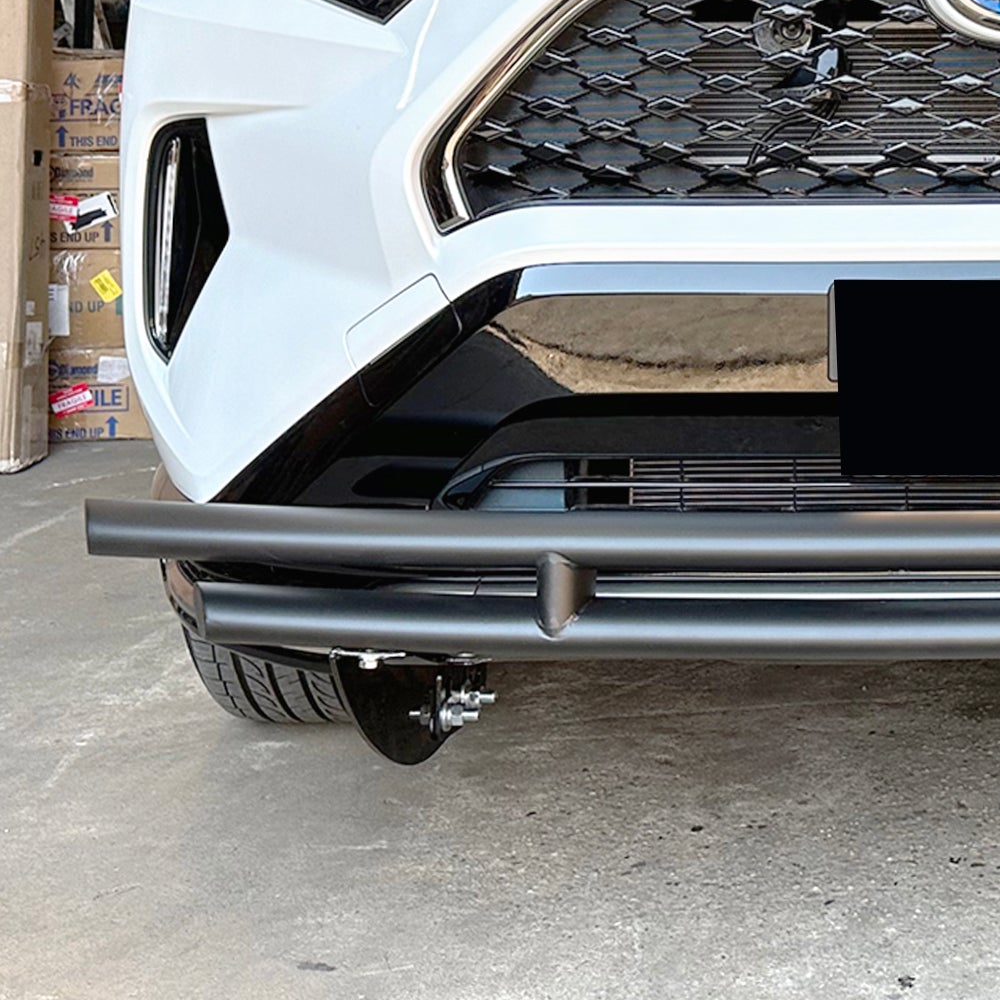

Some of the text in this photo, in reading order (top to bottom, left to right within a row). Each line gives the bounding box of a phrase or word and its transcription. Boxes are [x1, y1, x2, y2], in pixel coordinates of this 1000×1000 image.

[69, 135, 118, 147] THIS END
[60, 231, 82, 243] END
[84, 231, 100, 243] UP
[87, 300, 105, 313] UP
[65, 428, 87, 439] END
[89, 427, 104, 439] UP
